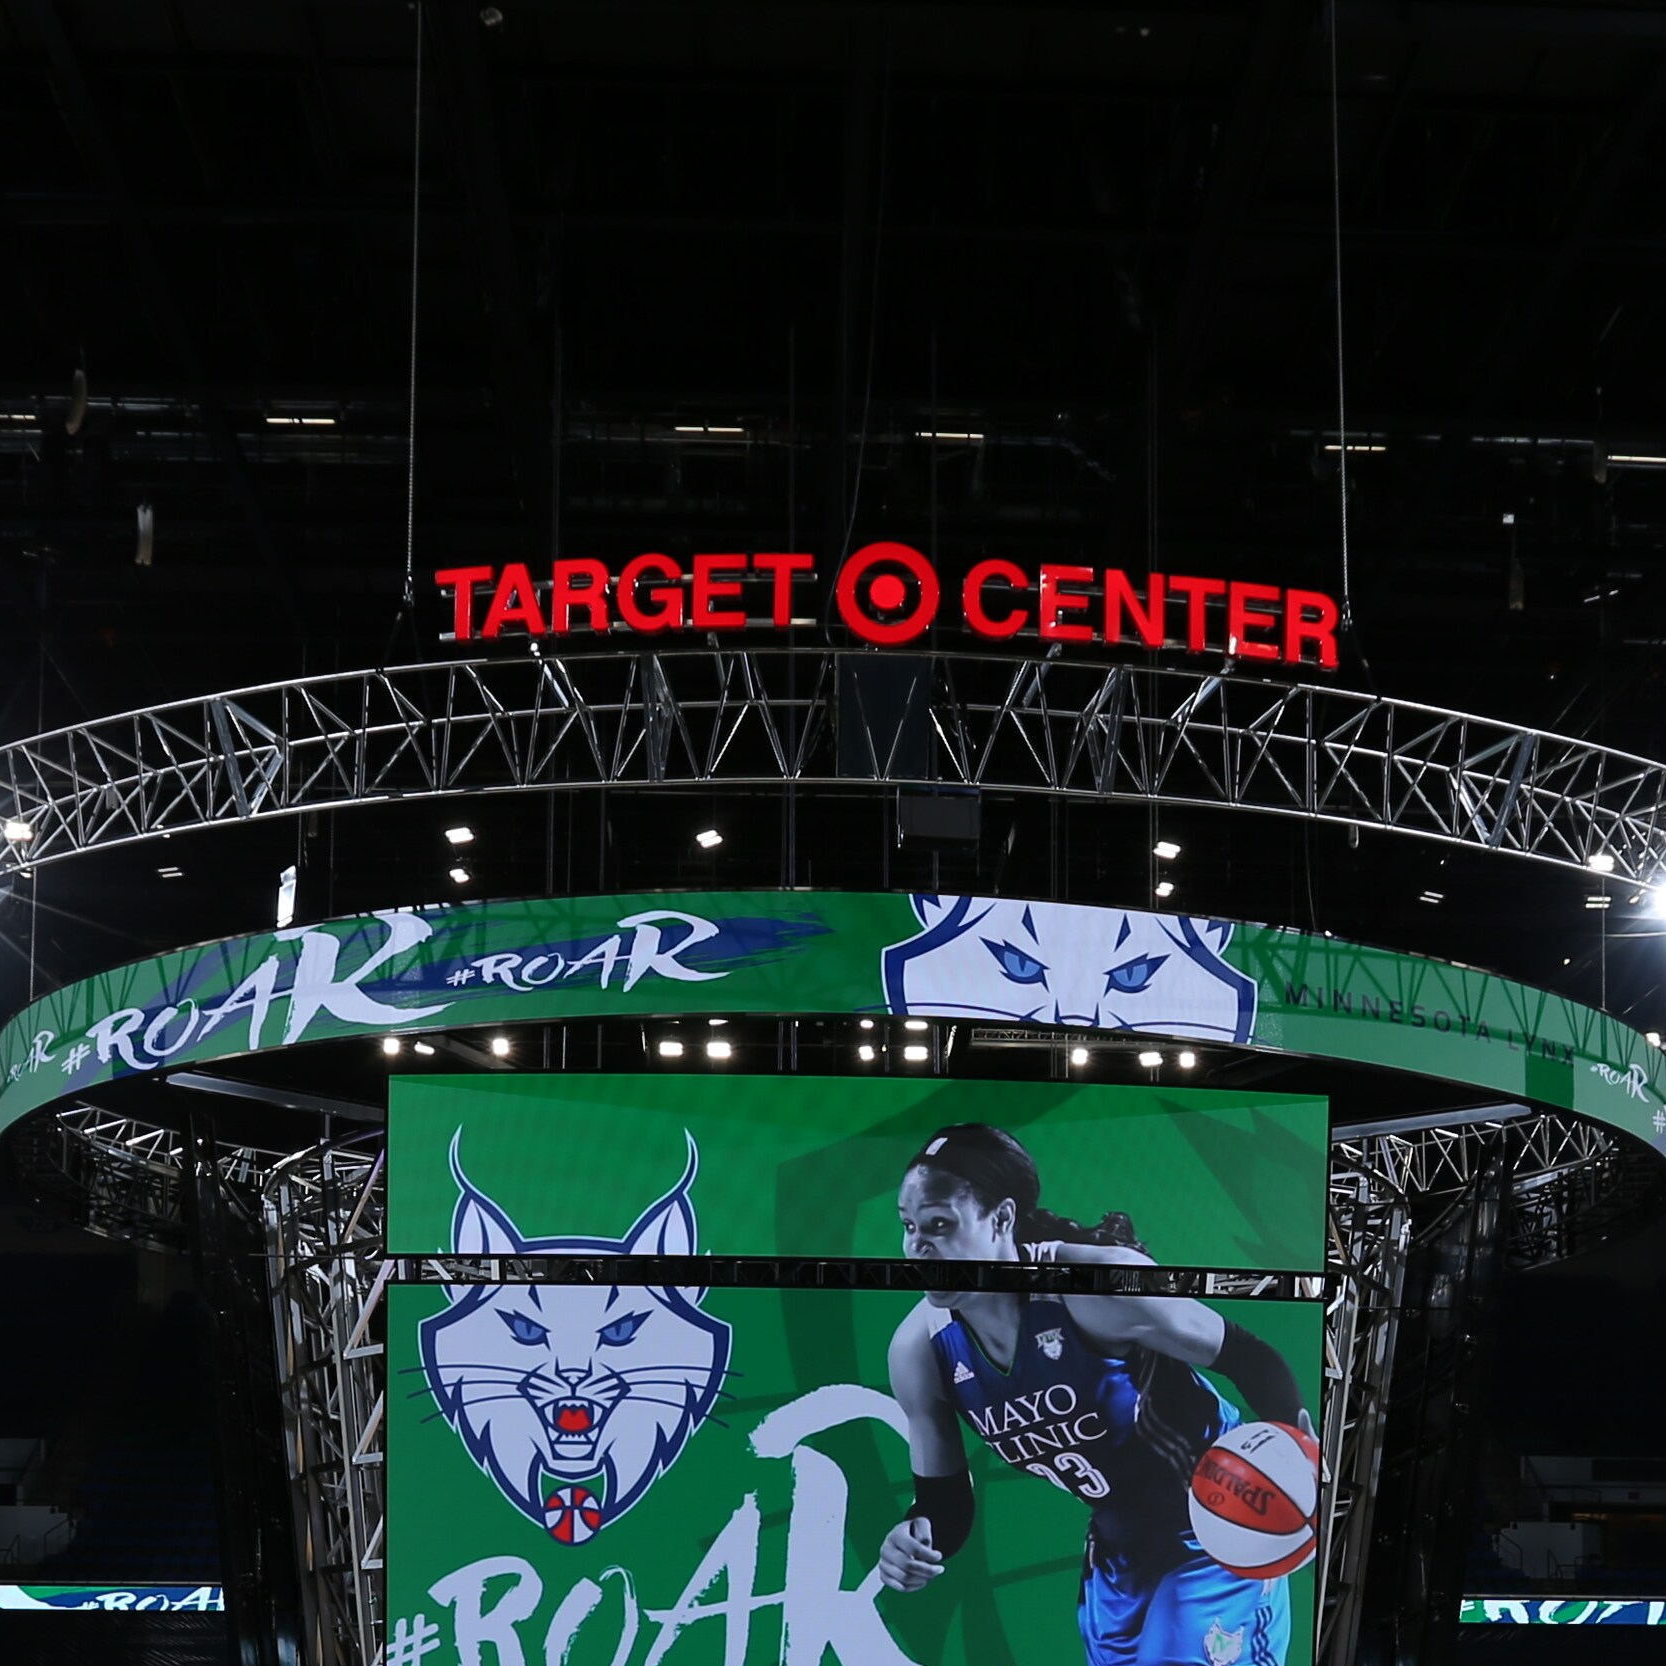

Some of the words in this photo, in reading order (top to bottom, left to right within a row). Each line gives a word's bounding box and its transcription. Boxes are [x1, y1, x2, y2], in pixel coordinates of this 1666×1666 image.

[435, 552, 815, 642] TARGET
[962, 558, 1340, 668] CENTER
[61, 912, 455, 1072] #ROAR
[1284, 982, 1493, 1042] MINNESOTA
[1507, 1028, 1575, 1066] LYNX
[968, 1384, 1078, 1437] MAYO
